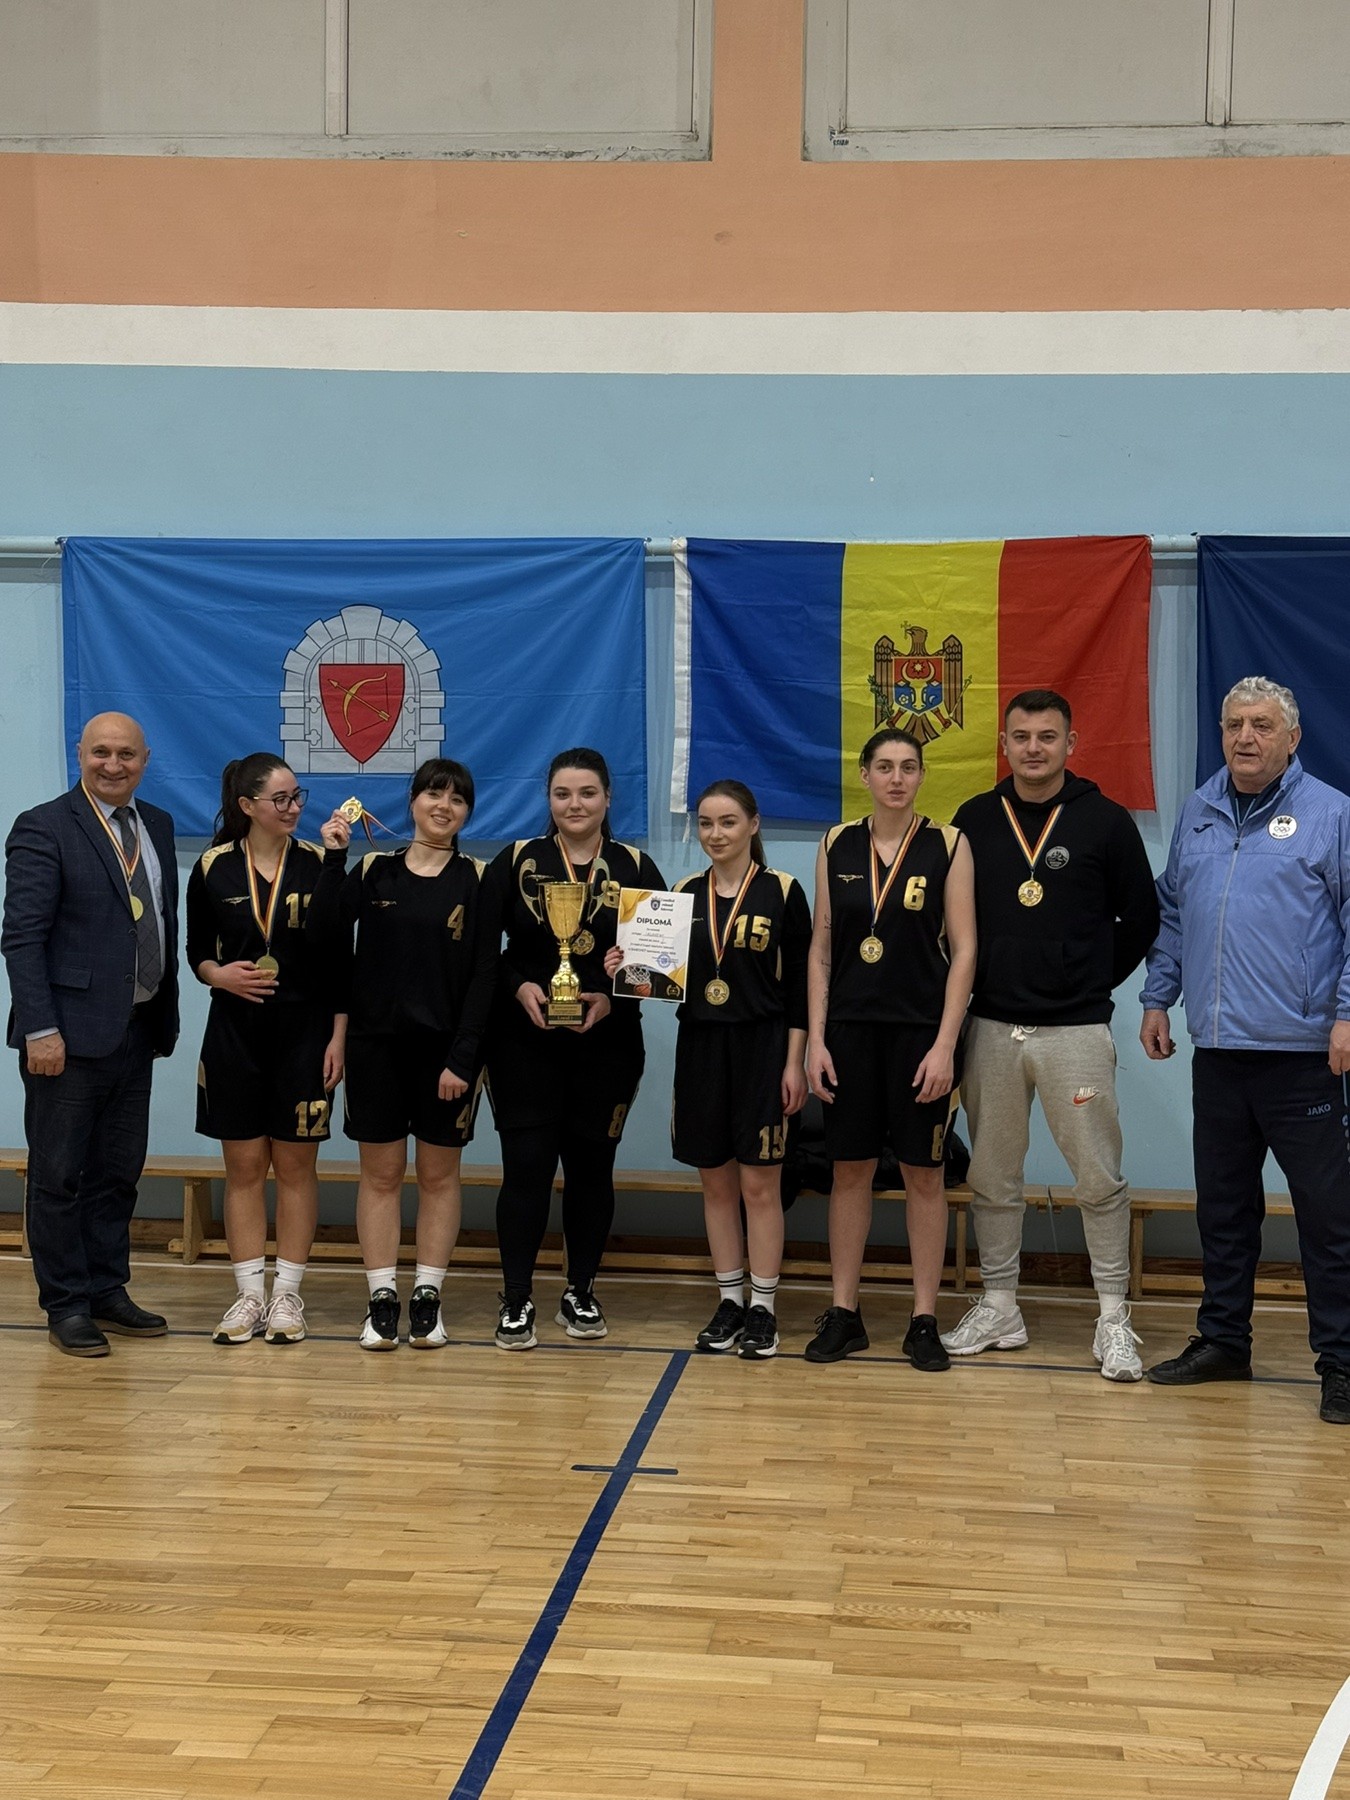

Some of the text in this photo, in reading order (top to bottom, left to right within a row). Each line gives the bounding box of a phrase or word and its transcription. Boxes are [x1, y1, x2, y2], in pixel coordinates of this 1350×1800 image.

[903, 875, 927, 911] 6
[447, 904, 465, 940] 4
[734, 914, 772, 952] 15
[295, 1100, 328, 1137] 12
[455, 1103, 471, 1140] 4
[608, 1103, 627, 1138] 8
[1306, 1103, 1331, 1116] JAKO
[759, 1125, 786, 1160] 15
